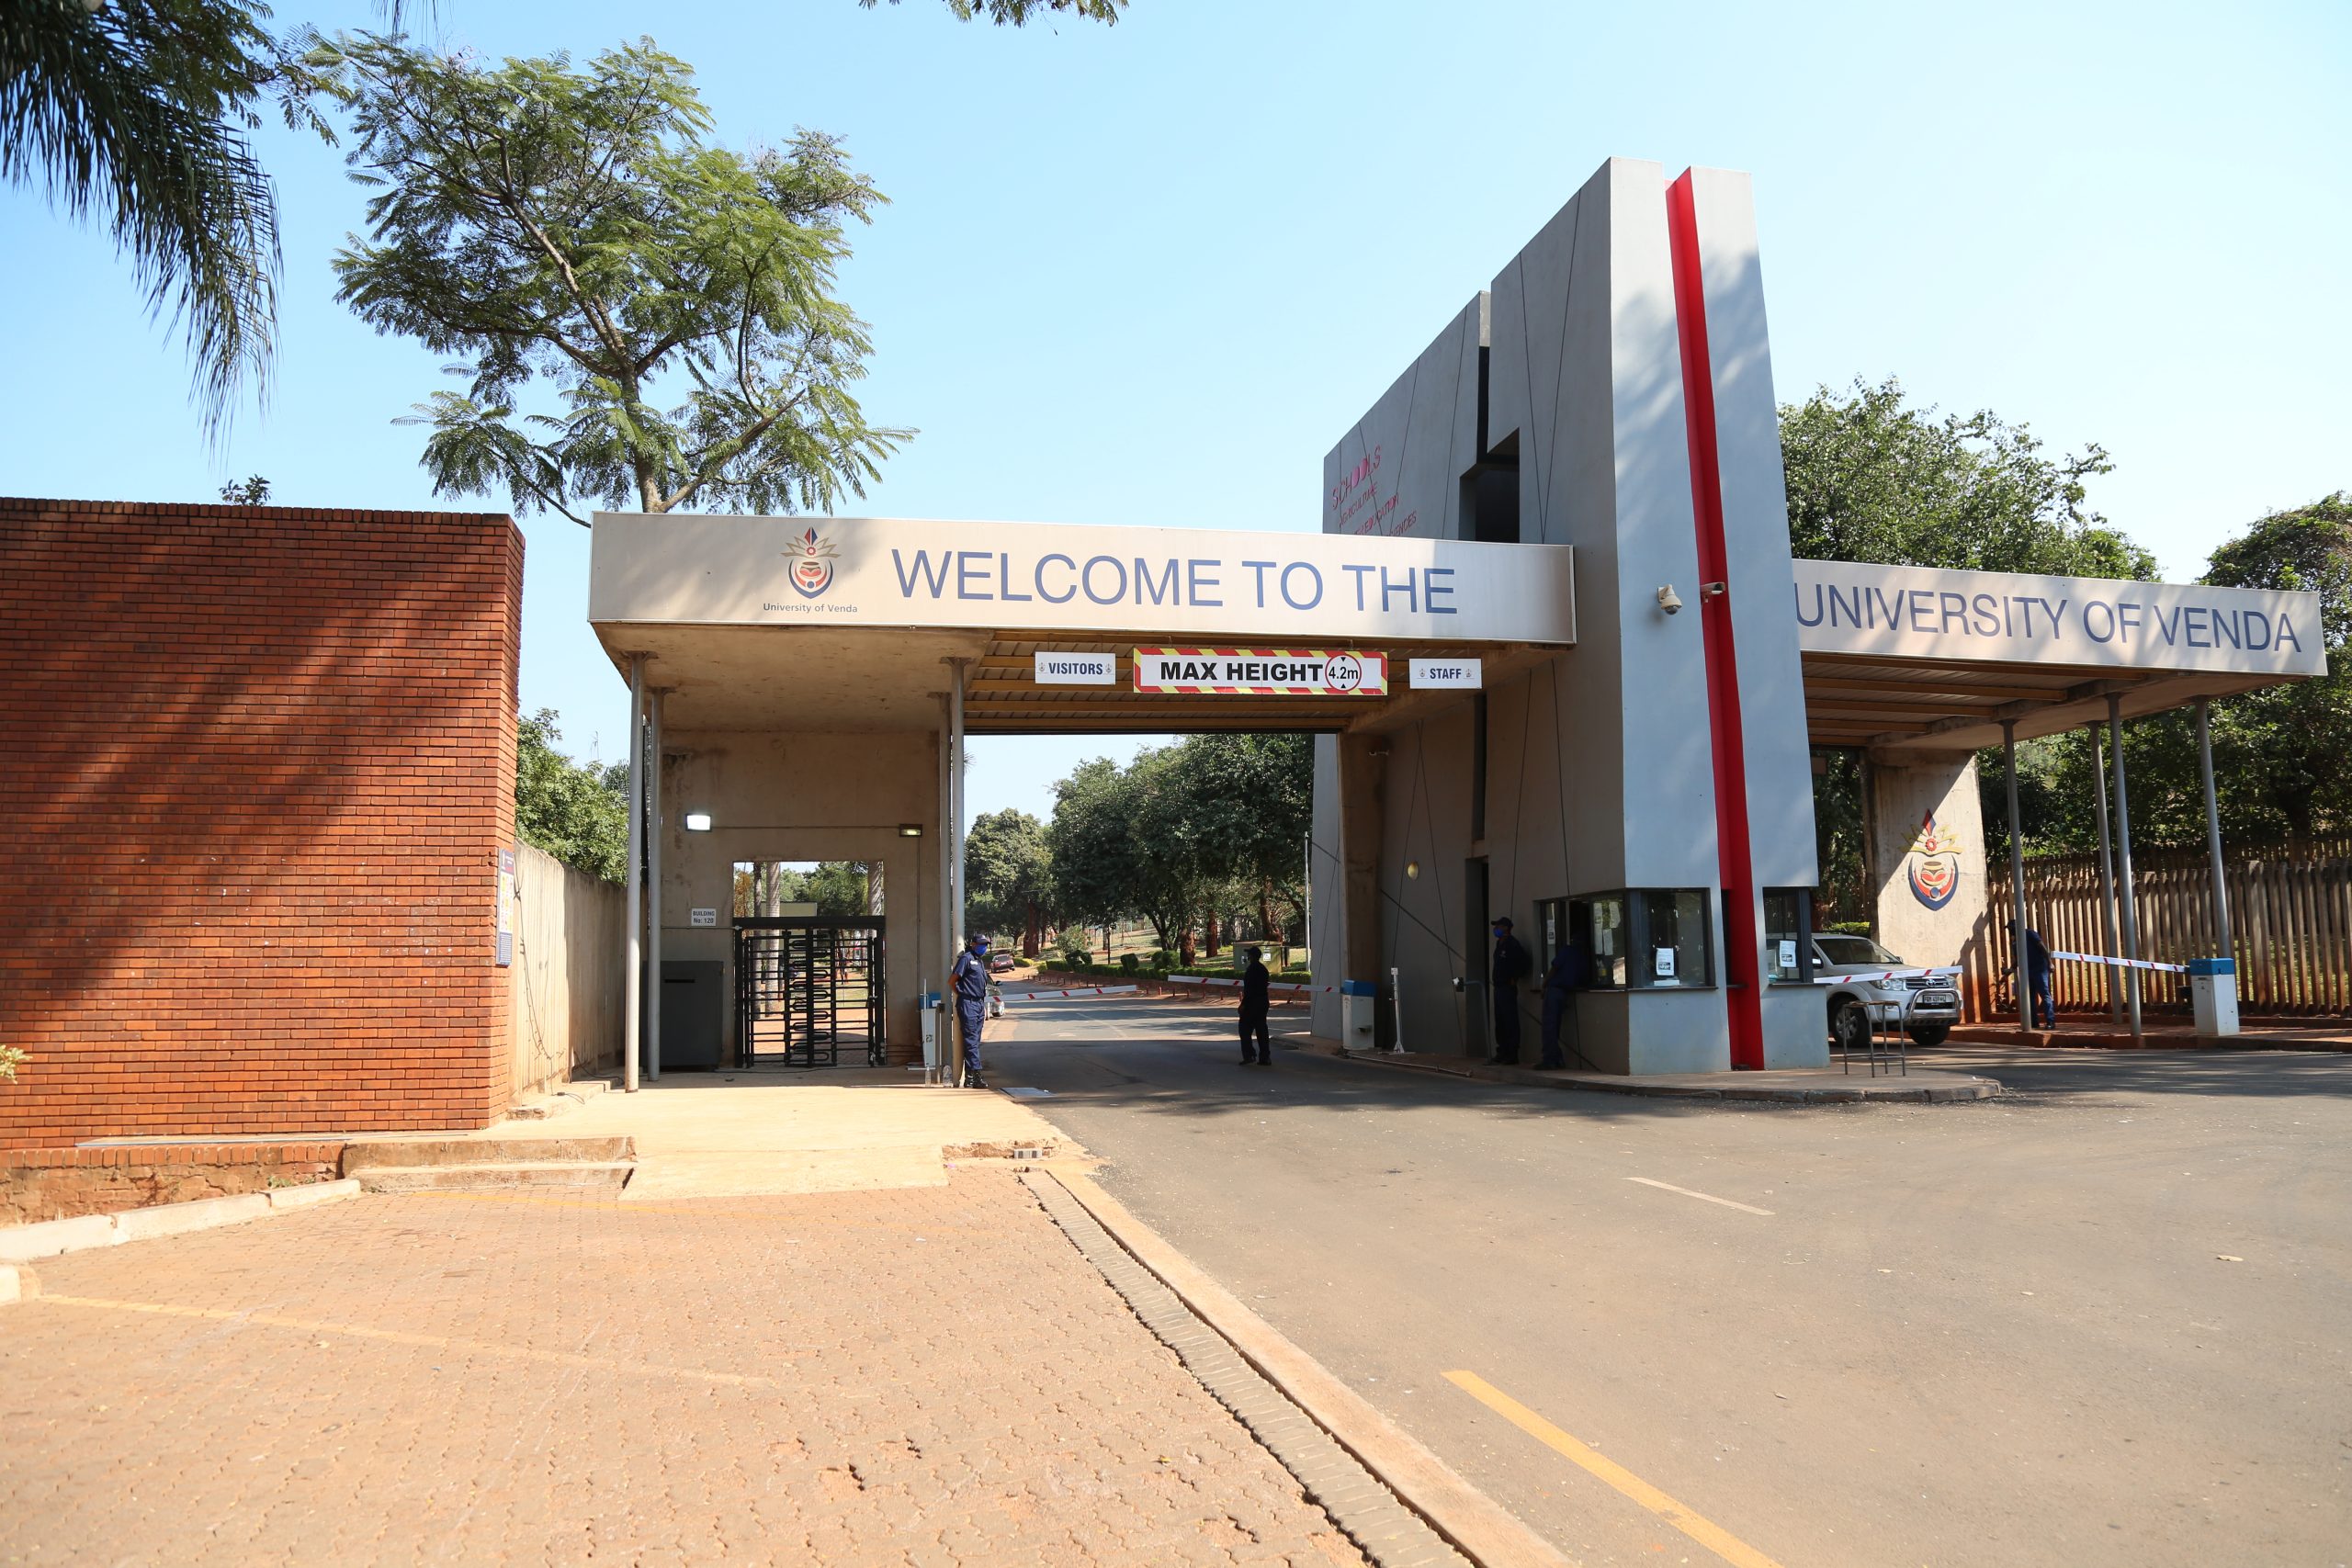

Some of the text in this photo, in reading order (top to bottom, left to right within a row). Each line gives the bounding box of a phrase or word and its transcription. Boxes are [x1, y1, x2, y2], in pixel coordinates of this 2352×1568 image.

[1331, 445, 1381, 511] SCHOOLS
[890, 548, 1458, 615] WELCOME TO THE
[763, 603, 858, 614] University of Venda
[1793, 582, 2302, 653] UNIVERSITY OF VENDA
[1048, 662, 1103, 675] VISITORS
[1160, 661, 1324, 682] MAX HEIGHT
[1328, 666, 1359, 680] 4.2m
[1430, 668, 1462, 679] STAFF
